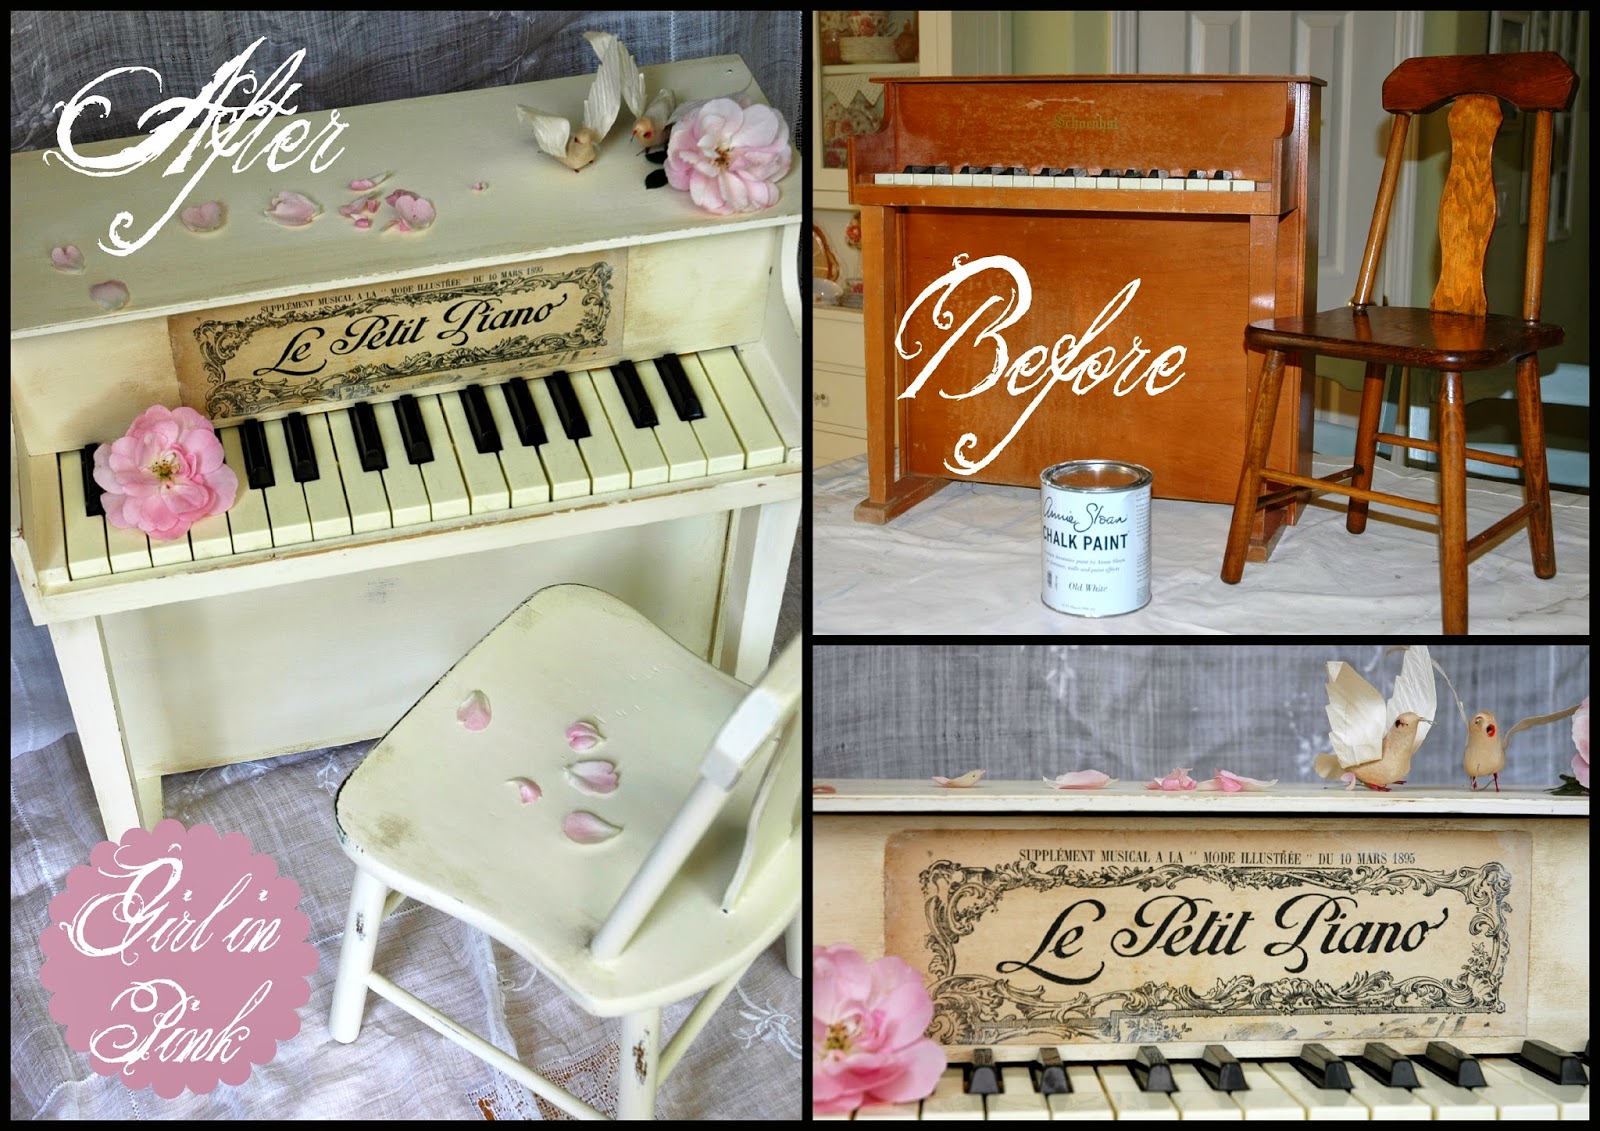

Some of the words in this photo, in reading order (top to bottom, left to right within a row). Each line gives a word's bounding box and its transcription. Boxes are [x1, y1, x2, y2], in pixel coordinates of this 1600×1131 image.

[318, 294, 354, 305] MUSICAL
[366, 290, 377, 299] LA
[391, 284, 414, 295] MODE
[473, 275, 485, 284] DU
[489, 273, 497, 281] 10
[501, 270, 524, 279] MARS
[527, 265, 544, 275] 1895
[252, 326, 328, 376] Le
[330, 313, 430, 354] Petit
[437, 293, 568, 347] Piano
[1043, 496, 1076, 525] Annie
[1073, 502, 1128, 533] Sloan
[1042, 525, 1078, 550] CHALK
[1083, 533, 1128, 551] PAINT
[1068, 582, 1083, 592] Old
[1085, 583, 1108, 593] White
[1019, 847, 1095, 862] SUPPLÉMENT
[1100, 850, 1151, 863] MUSICAL
[1169, 851, 1184, 863] LA
[1203, 851, 1235, 864] MODE
[1240, 849, 1302, 865] ILLUSTRÉE
[1318, 853, 1334, 865] DU
[1339, 853, 1352, 865] 10
[1357, 853, 1388, 865] MARS
[1392, 852, 1416, 865] 1895
[996, 899, 1106, 985] Le
[1110, 895, 1255, 958] Petit
[1263, 893, 1449, 974] Piano
